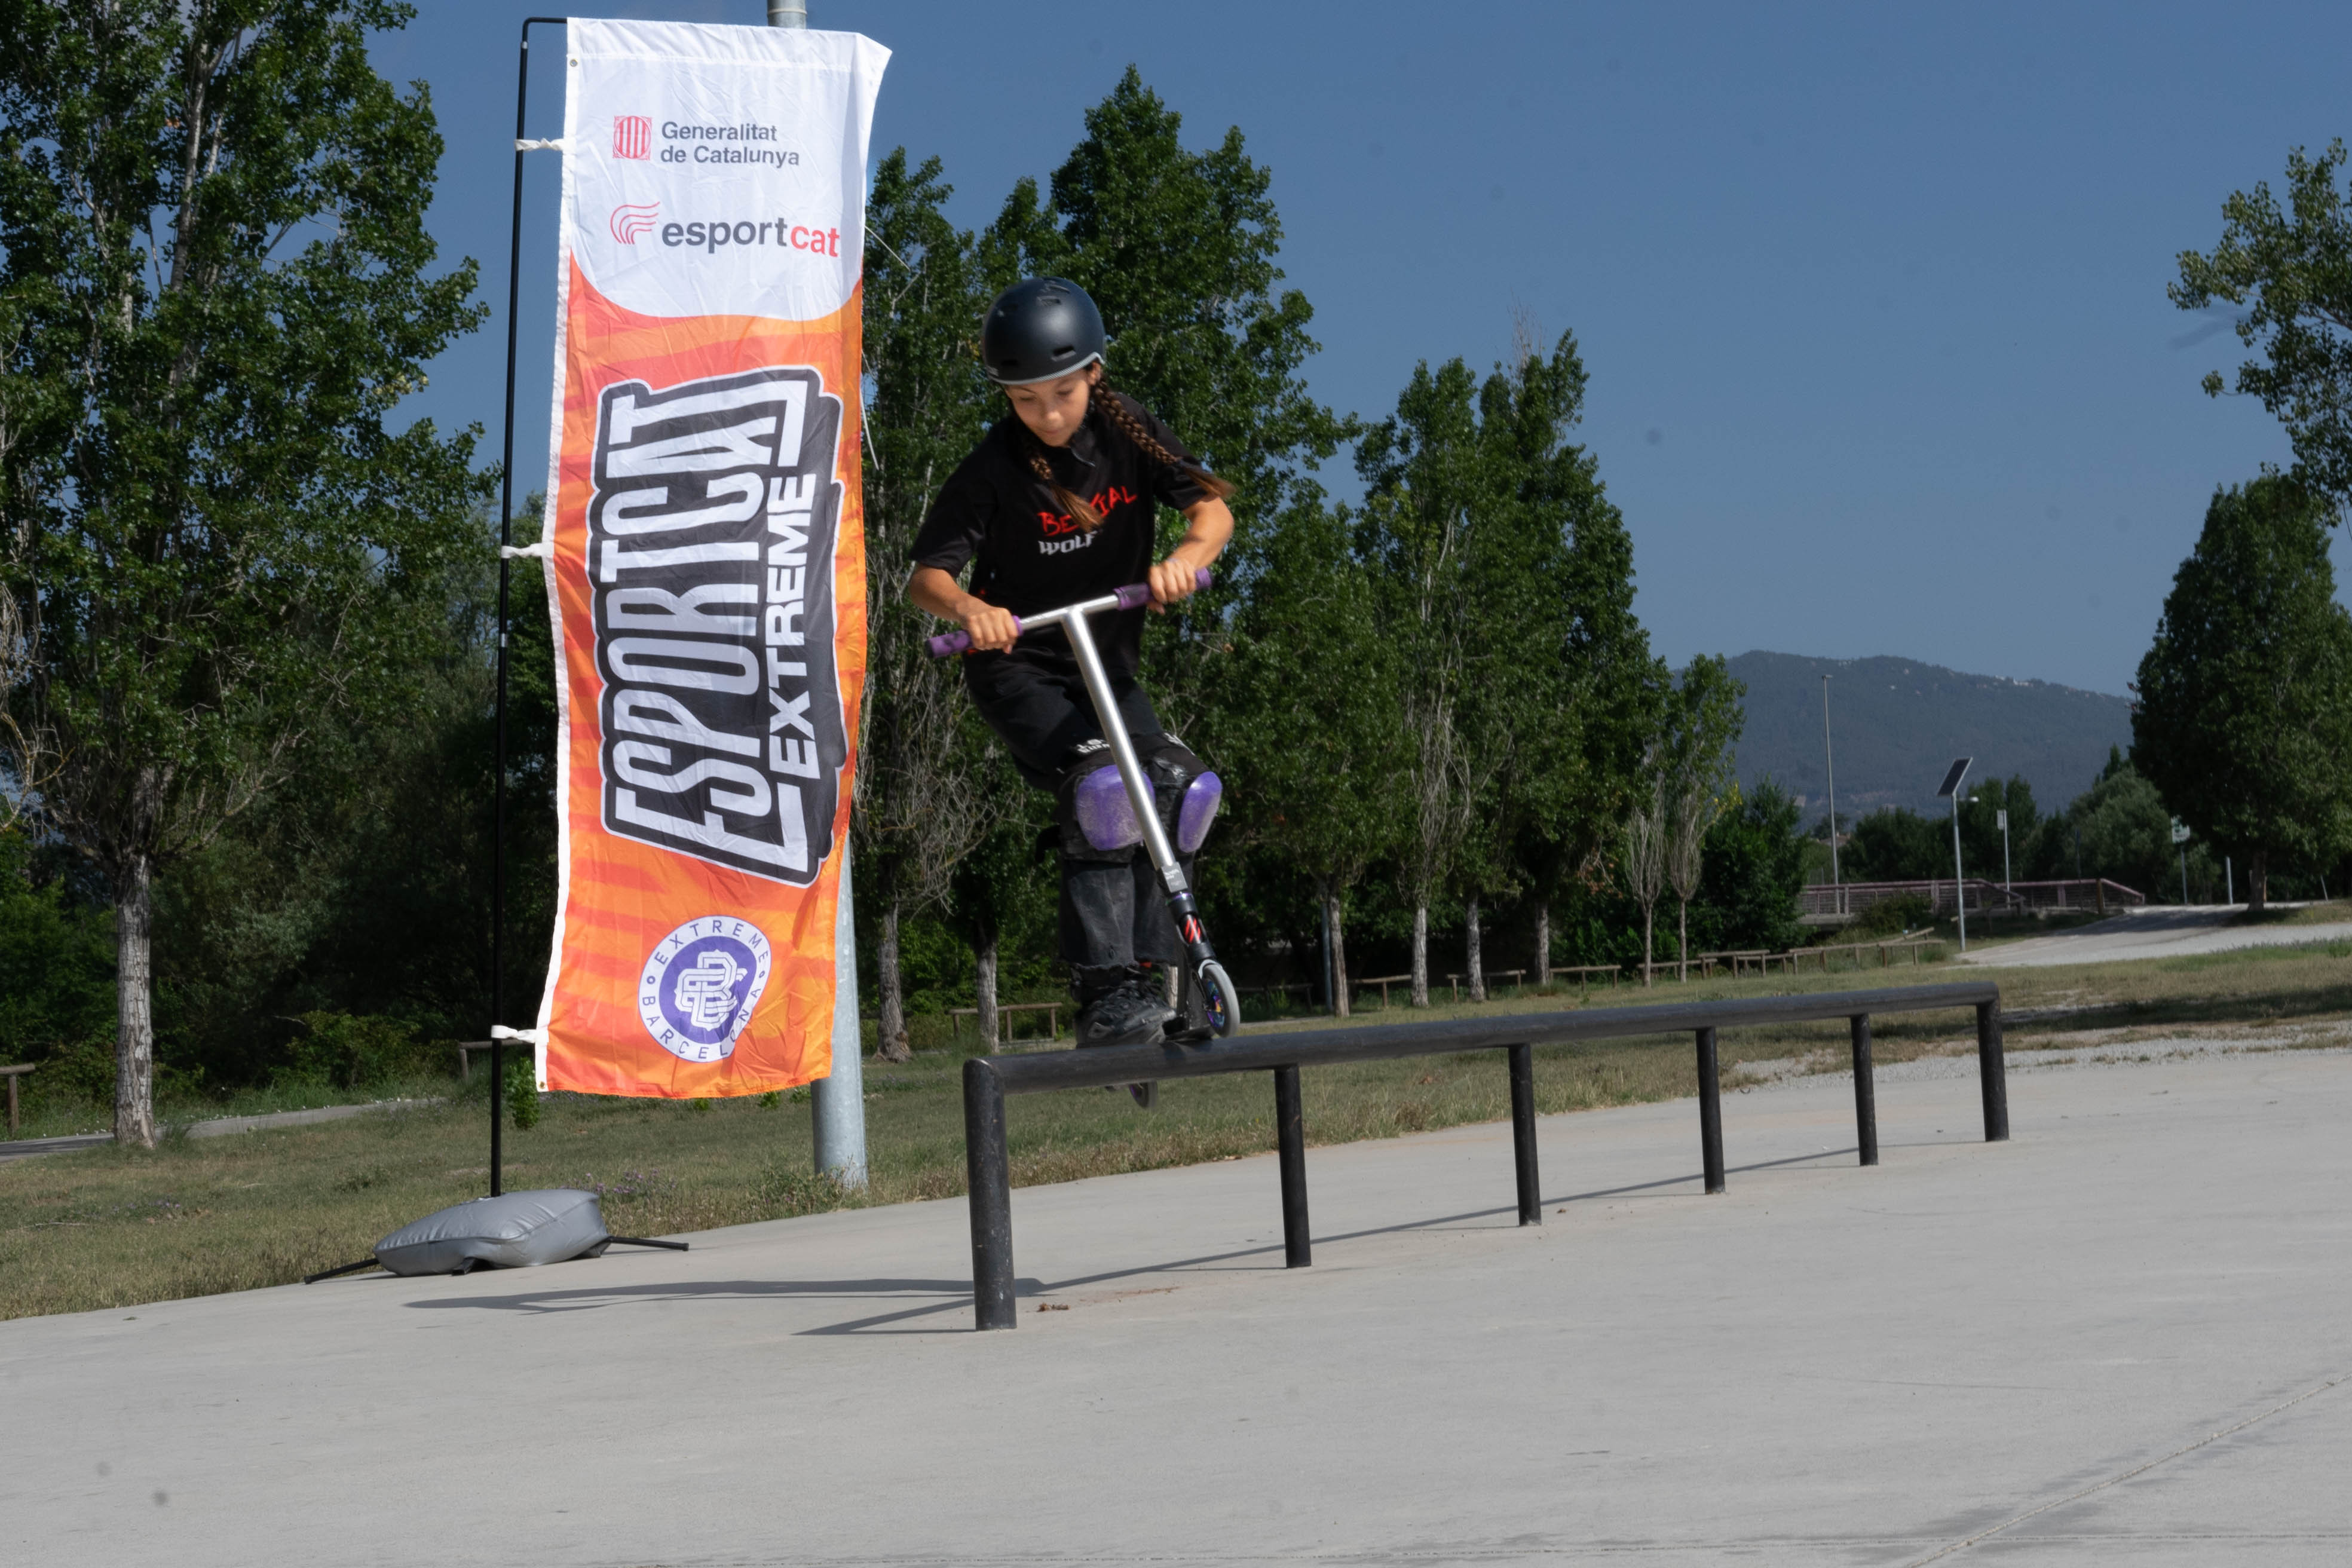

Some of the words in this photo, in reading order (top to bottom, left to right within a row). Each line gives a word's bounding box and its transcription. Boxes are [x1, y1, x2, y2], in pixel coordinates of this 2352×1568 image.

[662, 121, 777, 142] Generalitat
[660, 146, 687, 163] de
[694, 146, 800, 168] Catalunya
[662, 218, 840, 258] esportcat
[1038, 530, 1098, 555] WOLF
[599, 380, 808, 872] ESPORTCAT
[766, 474, 820, 779] EXTREME
[654, 920, 768, 965] EXTREME
[642, 988, 761, 1059] BARCELONA
